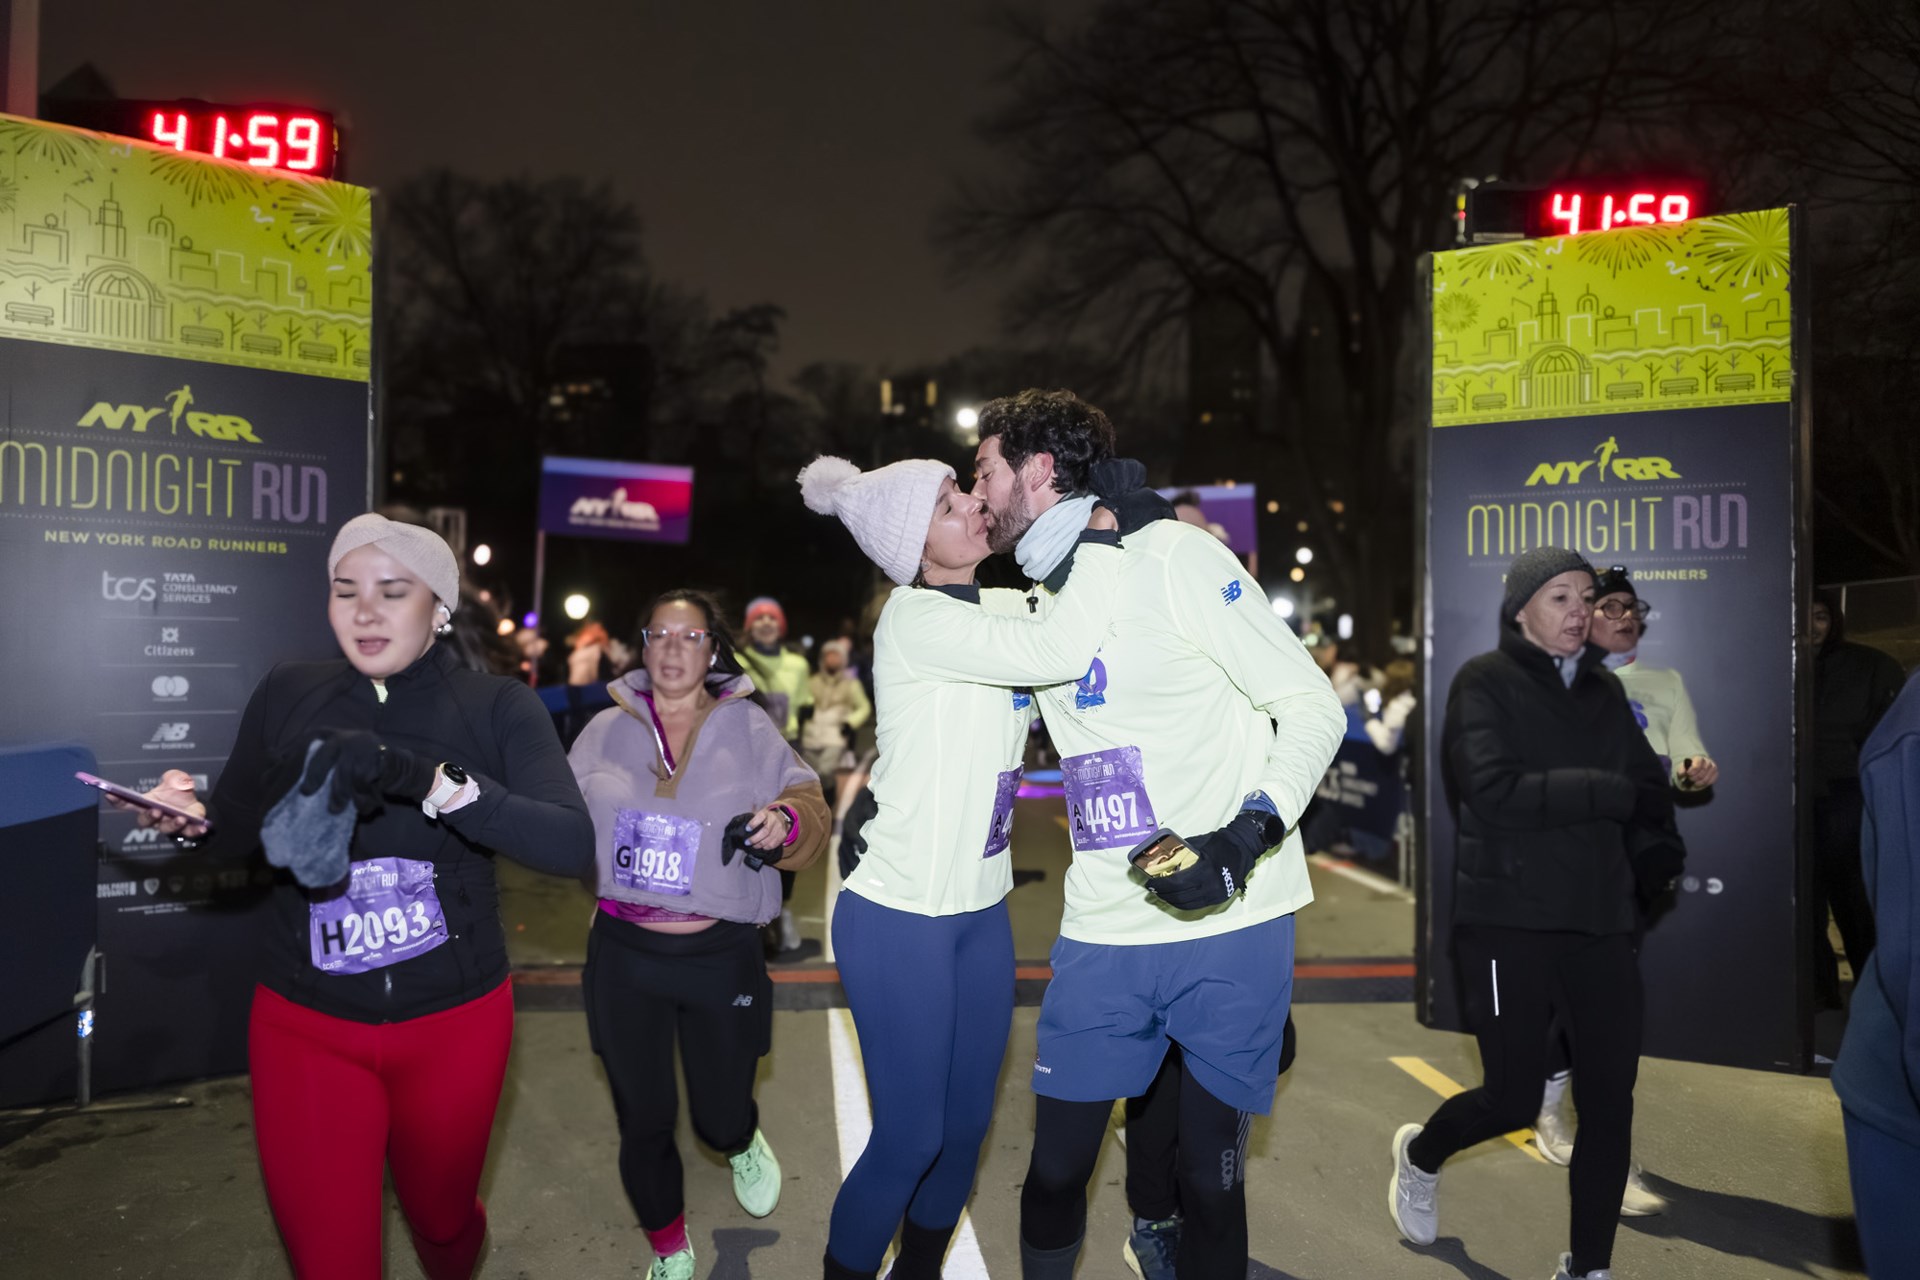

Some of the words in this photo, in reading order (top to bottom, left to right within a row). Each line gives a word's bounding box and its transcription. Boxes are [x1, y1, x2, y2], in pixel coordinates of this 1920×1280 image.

[0, 440, 242, 518] MIDNIGHT
[252, 462, 328, 524] RUN
[1468, 497, 1663, 555] MIDNIGHT
[1673, 493, 1748, 549] RUN
[45, 530, 90, 544] NEW
[95, 532, 145, 547] YORK
[152, 536, 202, 550] ROAD
[208, 540, 288, 554] RUNNERS
[163, 572, 196, 583] TATA
[1633, 569, 1708, 582] RUNNERS
[102, 570, 157, 601] tcs
[162, 583, 238, 595] CONSULTANCY
[162, 593, 211, 604] SERVICES
[144, 645, 195, 657] Citizens
[1085, 792, 1139, 834] 4497
[381, 872, 399, 887] RUN
